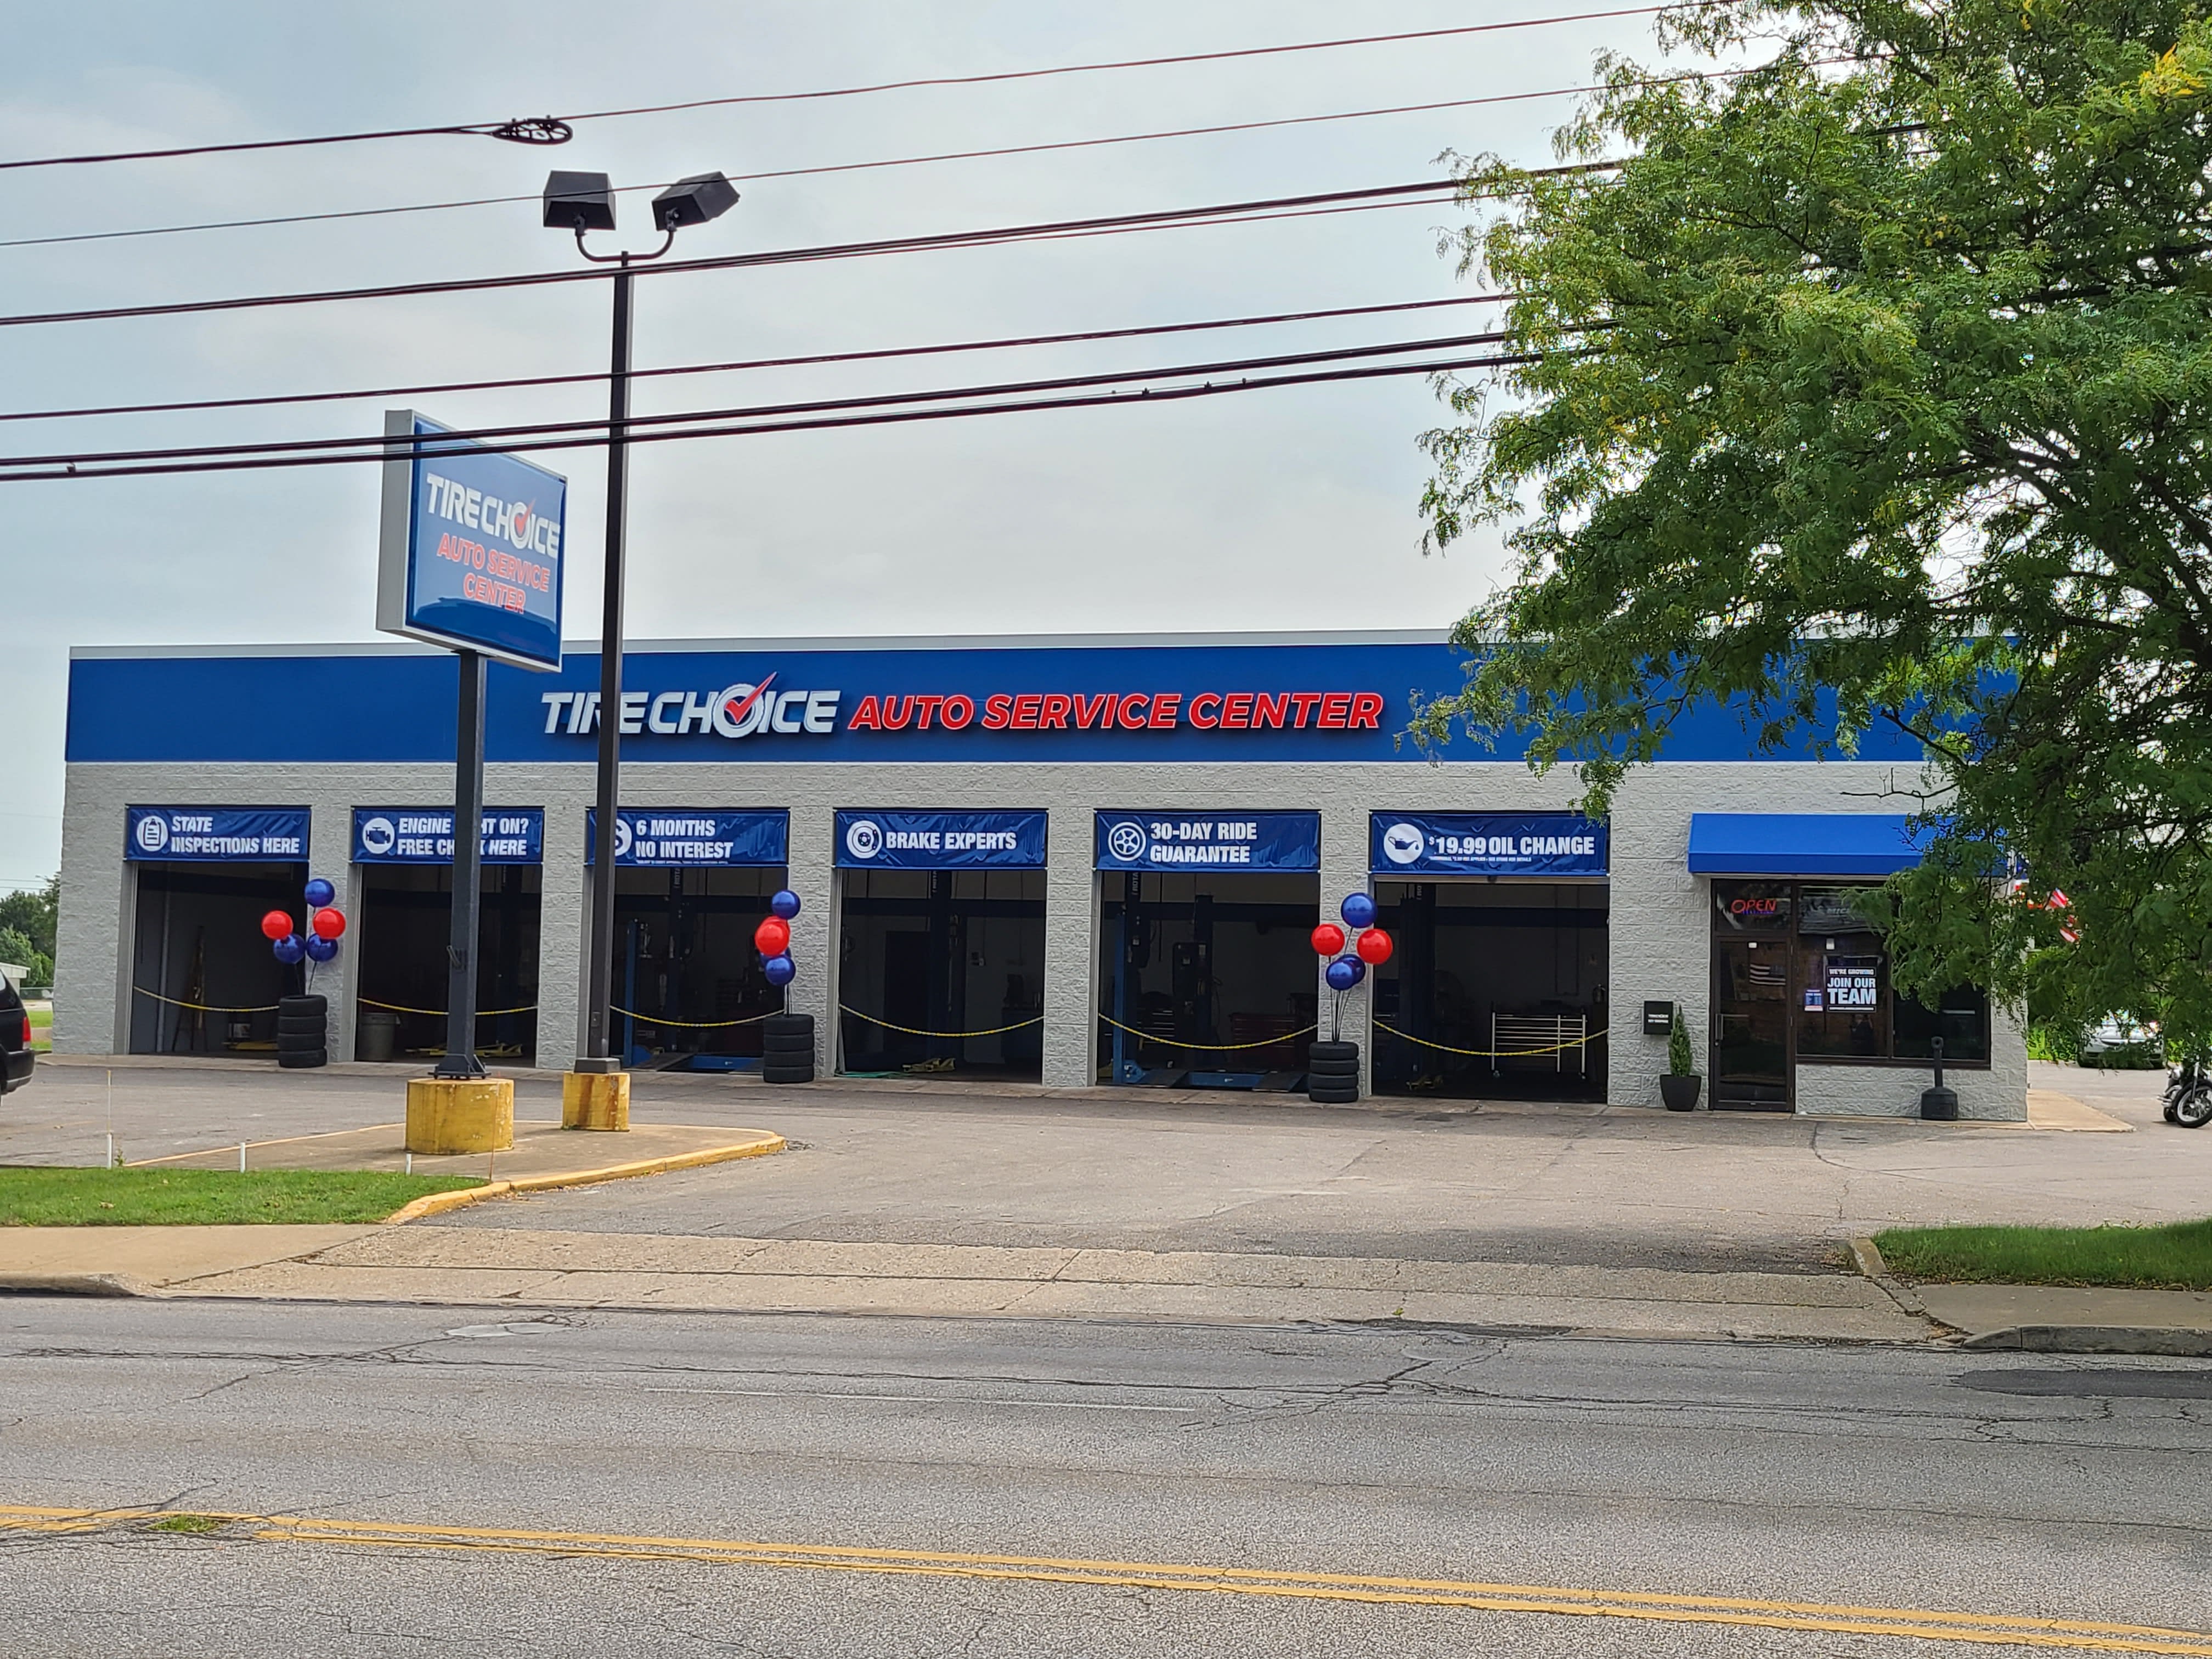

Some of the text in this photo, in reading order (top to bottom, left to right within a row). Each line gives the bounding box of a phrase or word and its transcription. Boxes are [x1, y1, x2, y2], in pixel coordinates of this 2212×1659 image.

[436, 533, 551, 592] AUTO SERVICE
[463, 572, 526, 614] CENTER
[848, 694, 975, 730] AUTO
[982, 693, 1182, 730] SERVICE
[1188, 692, 1383, 730] CENTER
[171, 816, 213, 833] STATE
[398, 817, 452, 834] ENGINE
[499, 818, 529, 834] ON?
[636, 820, 716, 837] 6 MONTHS
[1150, 822, 1257, 840] 30-DAY RIDE
[171, 837, 300, 854] INSPECTIONS HERE
[397, 839, 435, 855] FREE
[488, 839, 527, 855] HERE
[886, 832, 1017, 849] BRAKE EXPERTS
[1429, 836, 1595, 855] $19.99 OIL CHANGE
[635, 841, 733, 859] NO INTEREST
[1150, 846, 1250, 863] GUARANTEE
[1731, 899, 1777, 914] OPEN
[1827, 977, 1876, 988] JOIN OUR
[1827, 988, 1877, 1005] TEAM
